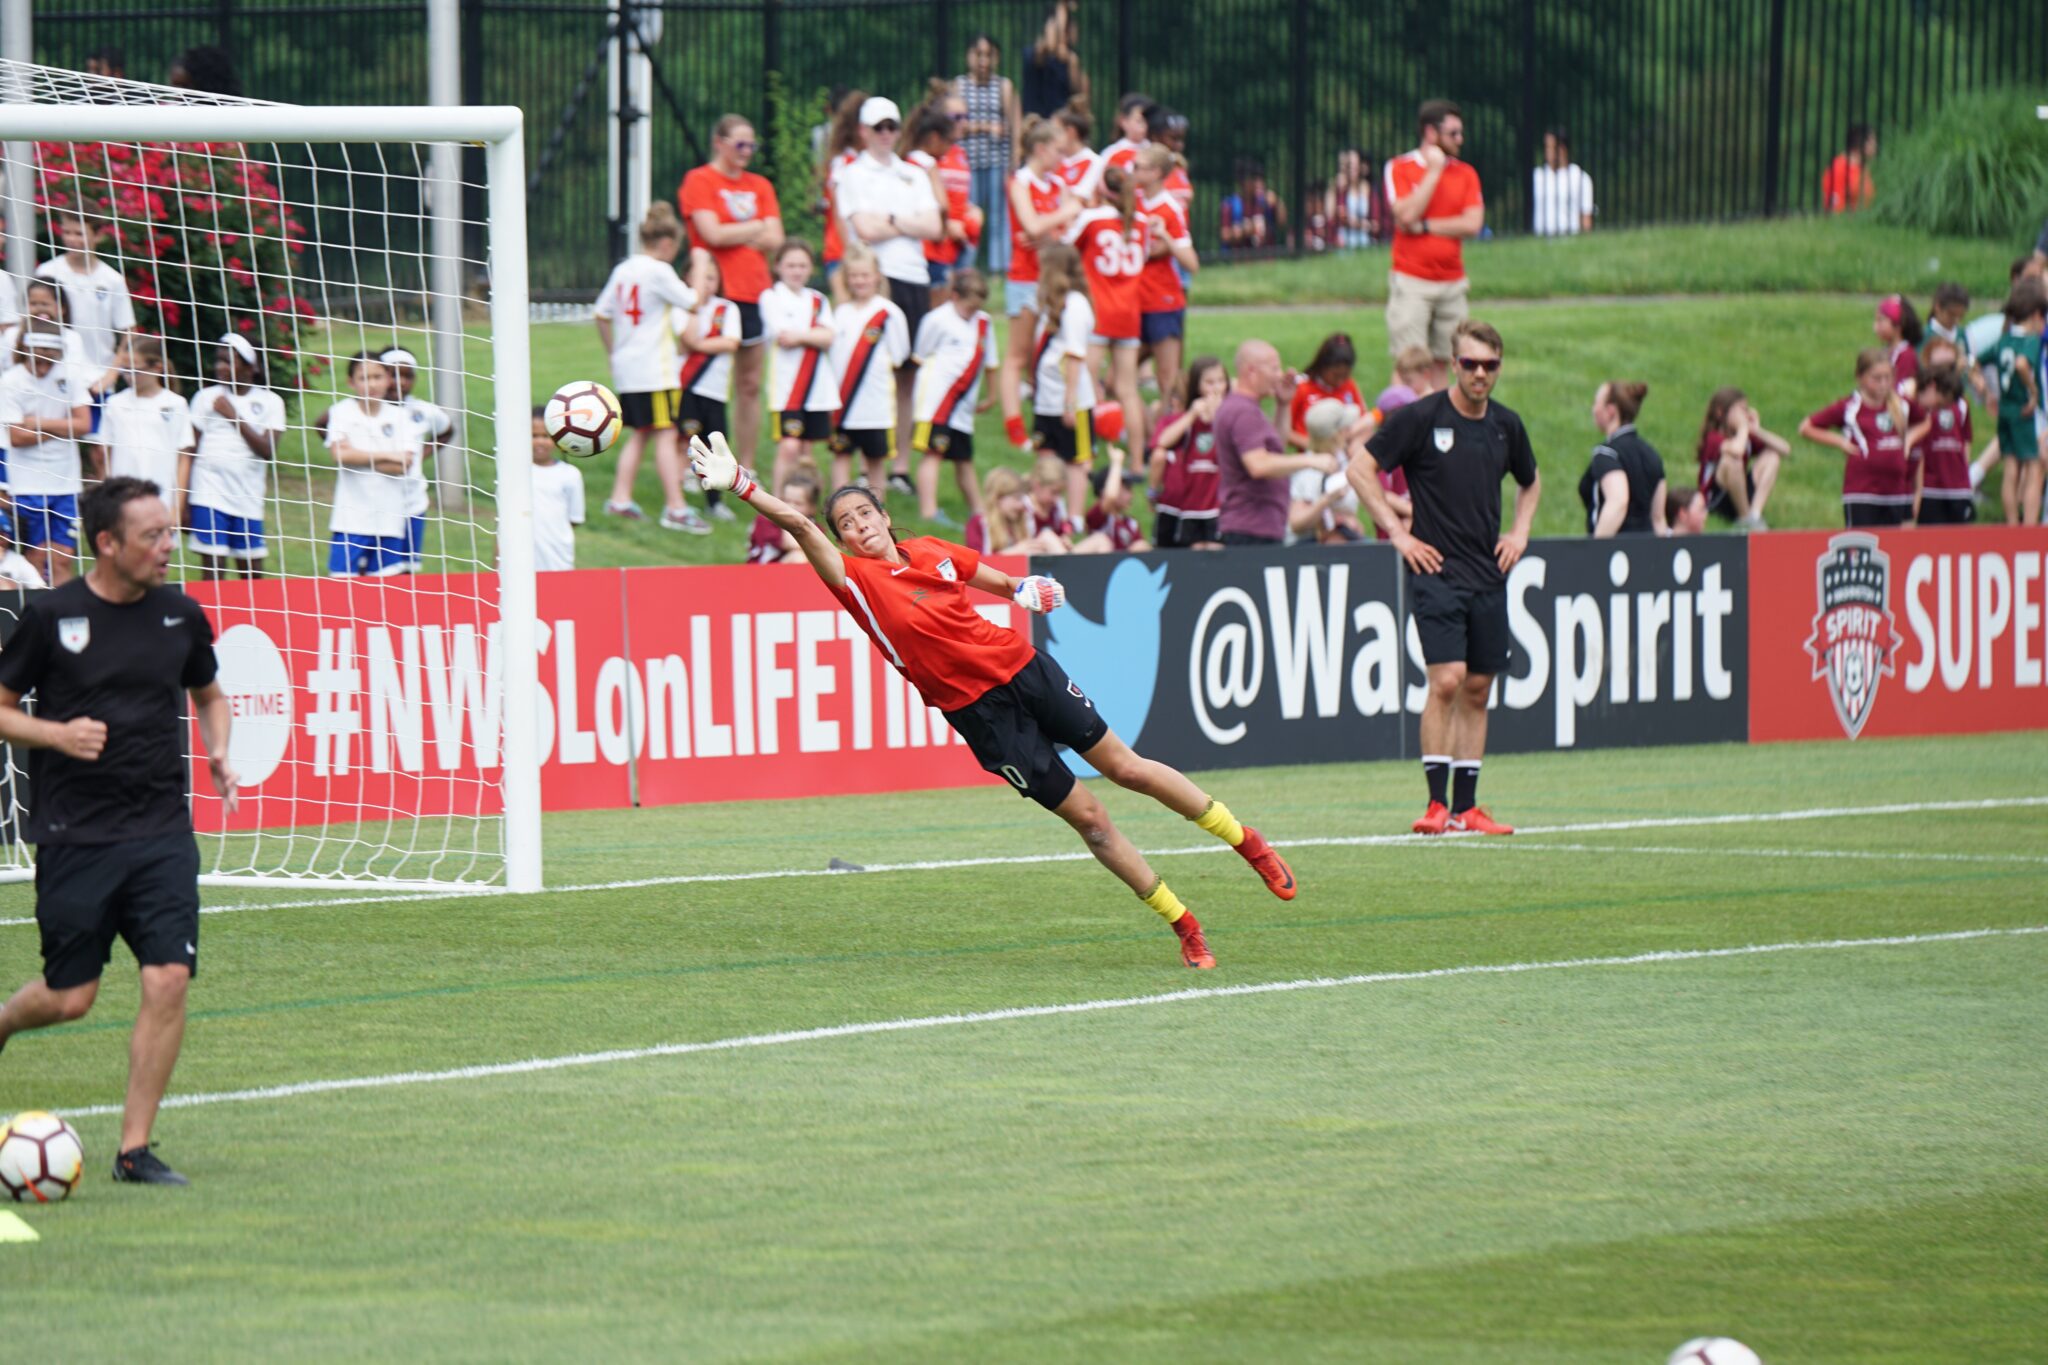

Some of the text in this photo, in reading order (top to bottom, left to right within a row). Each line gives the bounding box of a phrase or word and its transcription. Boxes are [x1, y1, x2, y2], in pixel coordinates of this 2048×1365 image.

[1189, 548, 1734, 747] @WasSpirit
[1826, 605, 1881, 643] SPIRIT
[1905, 551, 2048, 692] SUPE
[224, 693, 285, 717] ETIME
